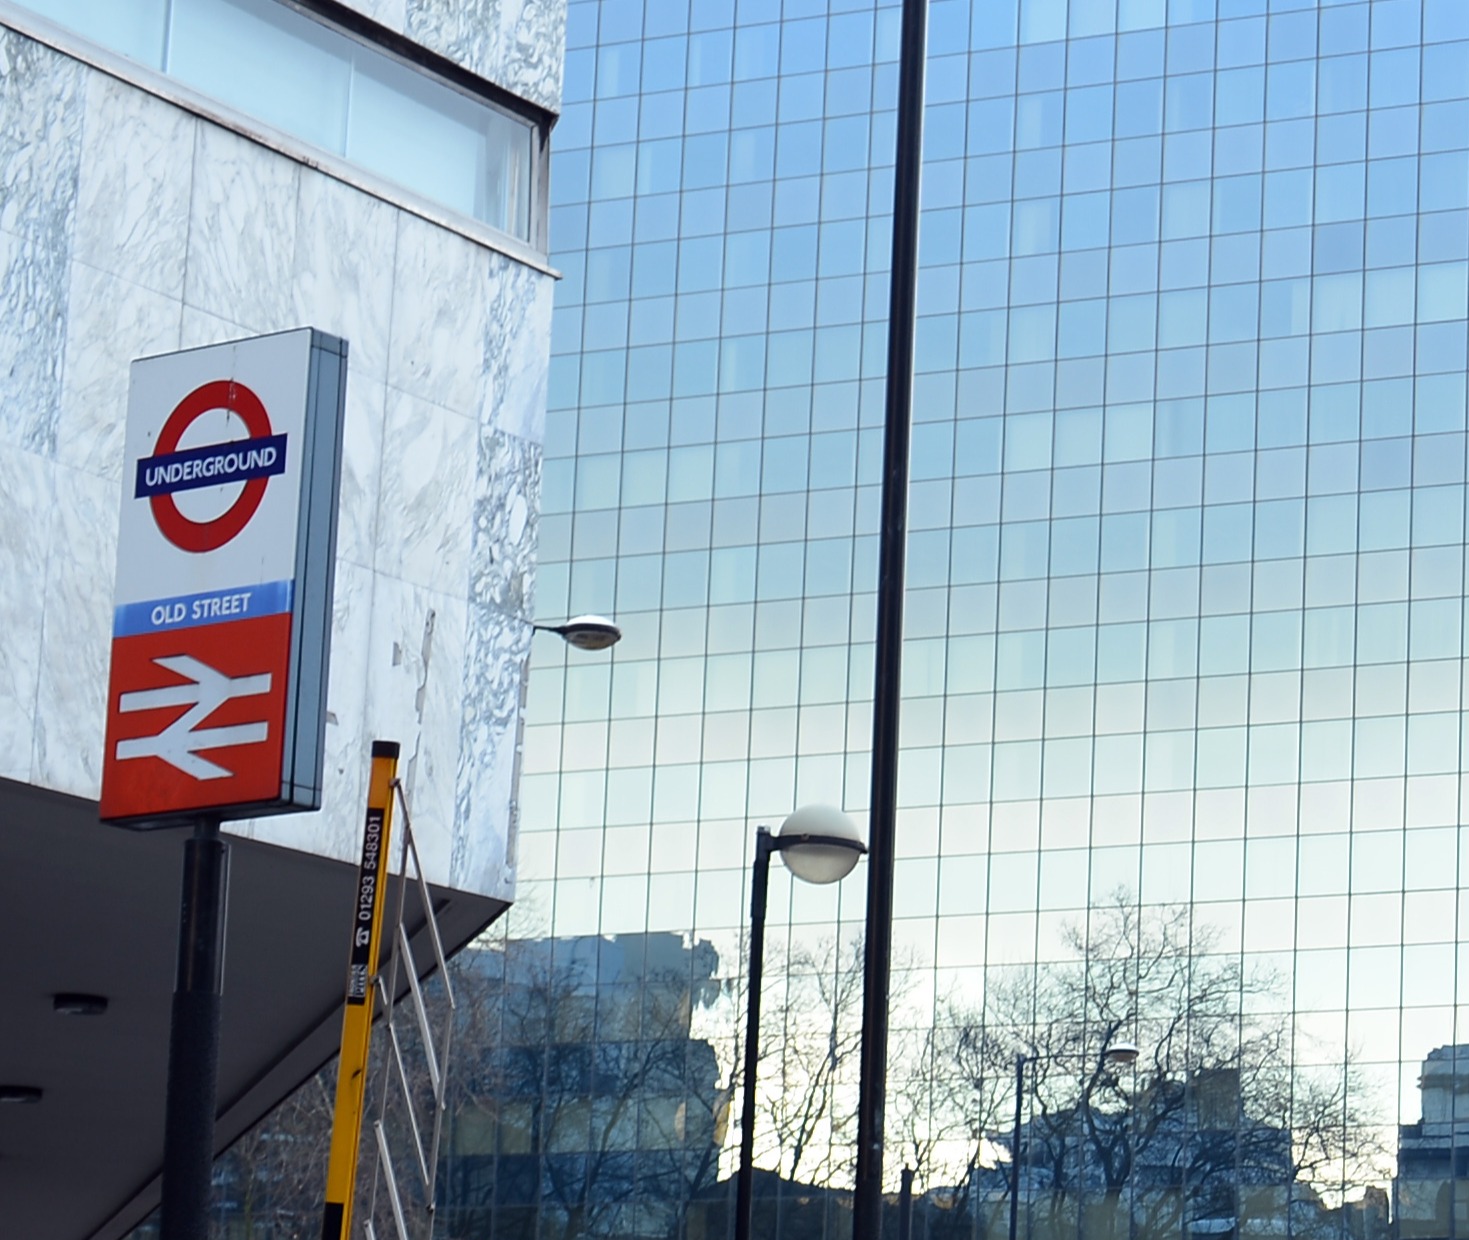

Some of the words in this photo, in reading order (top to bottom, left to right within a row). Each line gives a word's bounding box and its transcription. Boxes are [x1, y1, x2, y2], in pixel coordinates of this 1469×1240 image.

[145, 446, 278, 488] UNDERGROUND
[151, 602, 187, 625] OLD
[191, 592, 252, 620] STREET
[364, 815, 381, 870] 548301
[358, 875, 375, 921] 01293
